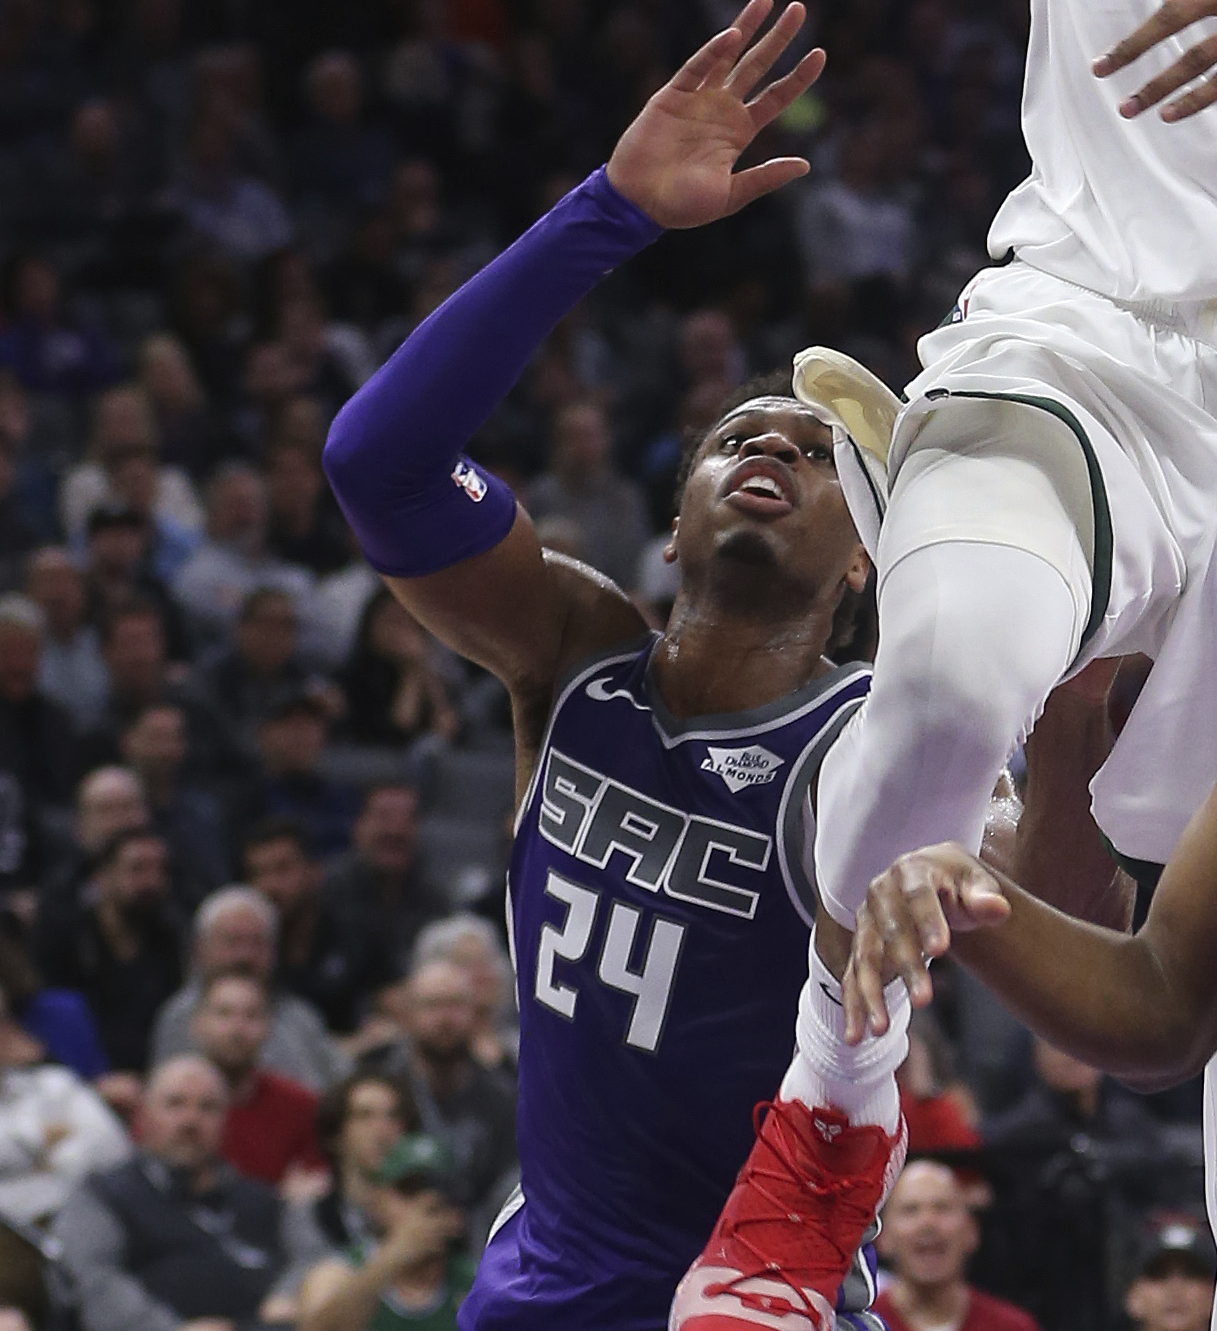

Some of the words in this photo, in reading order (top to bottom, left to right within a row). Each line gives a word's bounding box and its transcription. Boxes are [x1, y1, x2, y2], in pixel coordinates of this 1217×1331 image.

[537, 747, 773, 920] SAC
[703, 757, 774, 783] ALMONDS
[533, 868, 685, 1053] 24
